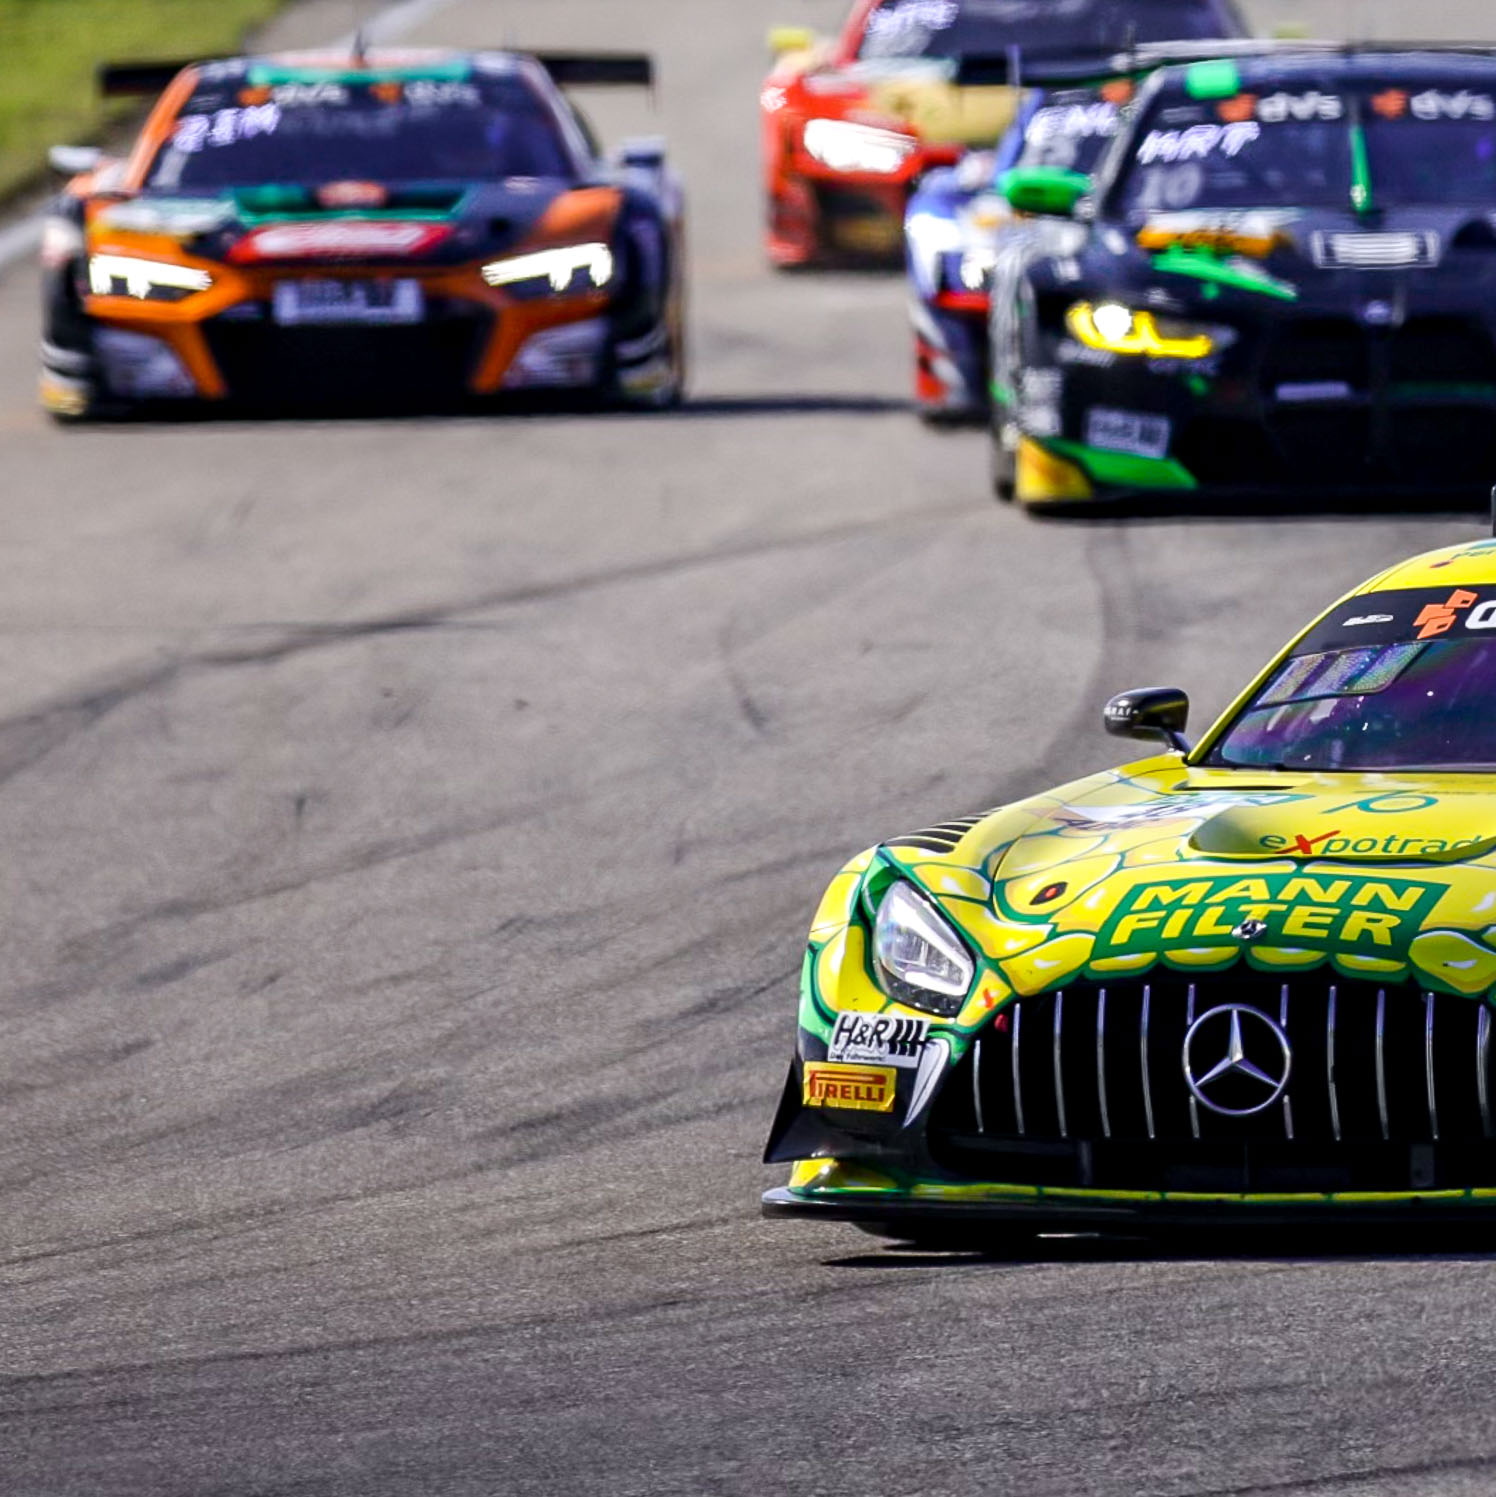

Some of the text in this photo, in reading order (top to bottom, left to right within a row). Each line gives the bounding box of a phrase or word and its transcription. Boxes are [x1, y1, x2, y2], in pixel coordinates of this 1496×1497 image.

[1256, 89, 1496, 123] dvs dvs
[1130, 877, 1428, 912] MANN
[1110, 904, 1402, 947] FILTER
[834, 1013, 892, 1050] H&R
[808, 1069, 888, 1103] PIRELLI
